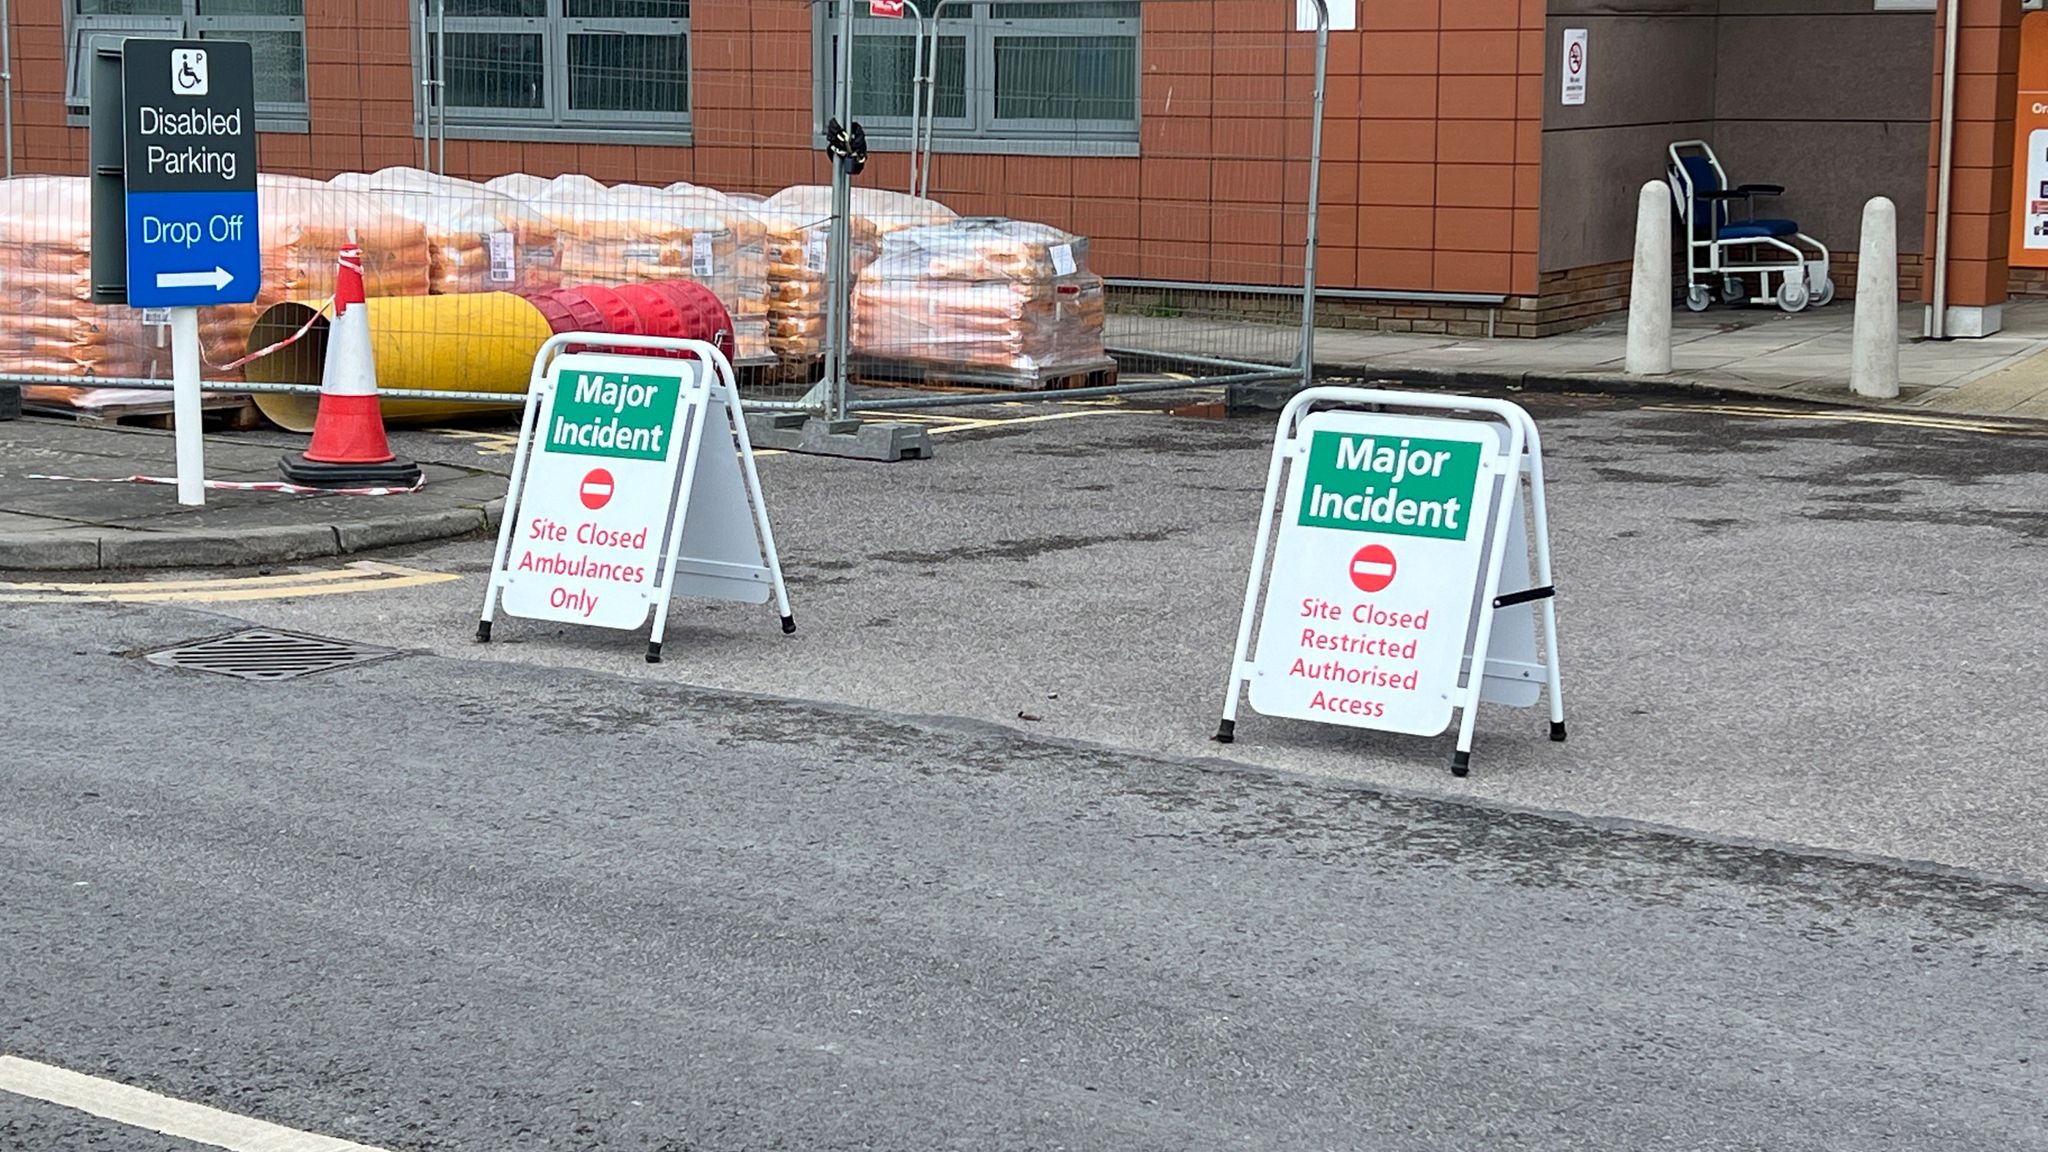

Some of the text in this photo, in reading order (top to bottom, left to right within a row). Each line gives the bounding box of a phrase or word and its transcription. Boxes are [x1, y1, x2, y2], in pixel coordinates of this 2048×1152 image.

[195, 52, 203, 64] P
[140, 106, 241, 136] Disabled
[147, 145, 236, 180] Parking
[143, 214, 243, 249] Drop Off
[574, 374, 658, 414] Major
[553, 415, 663, 452] Incident
[1336, 437, 1450, 483] Major
[1308, 484, 1460, 530] Incident
[530, 518, 648, 550] Site Closed
[518, 551, 645, 583] Ambulances
[550, 587, 599, 618] Only
[1300, 598, 1430, 631] Site Closed
[1300, 628, 1417, 660] Restricted
[1289, 657, 1419, 691] Authorised
[1310, 690, 1385, 718] Access
